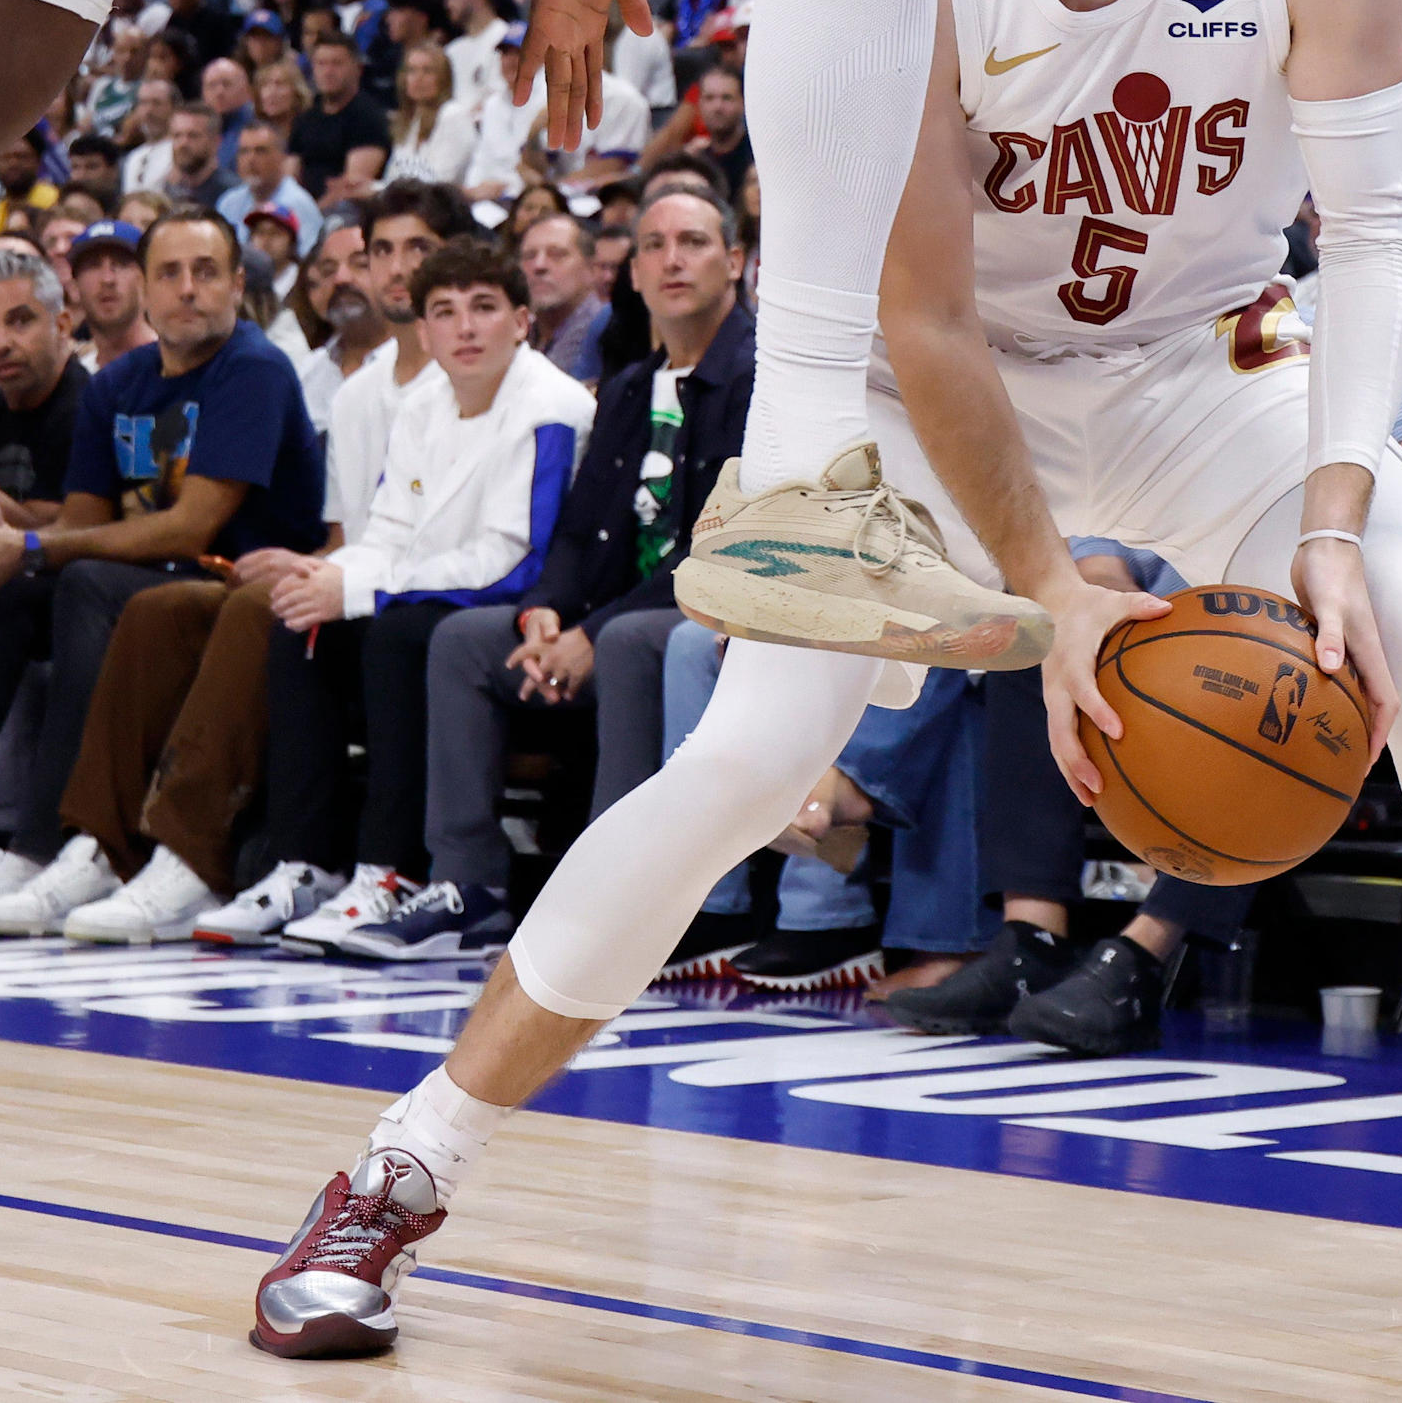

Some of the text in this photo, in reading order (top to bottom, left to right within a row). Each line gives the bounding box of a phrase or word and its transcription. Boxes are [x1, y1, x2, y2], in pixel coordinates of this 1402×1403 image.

[1167, 22, 1258, 38] CLIFFS
[983, 98, 1250, 216] CAVS
[1057, 215, 1149, 327] 5
